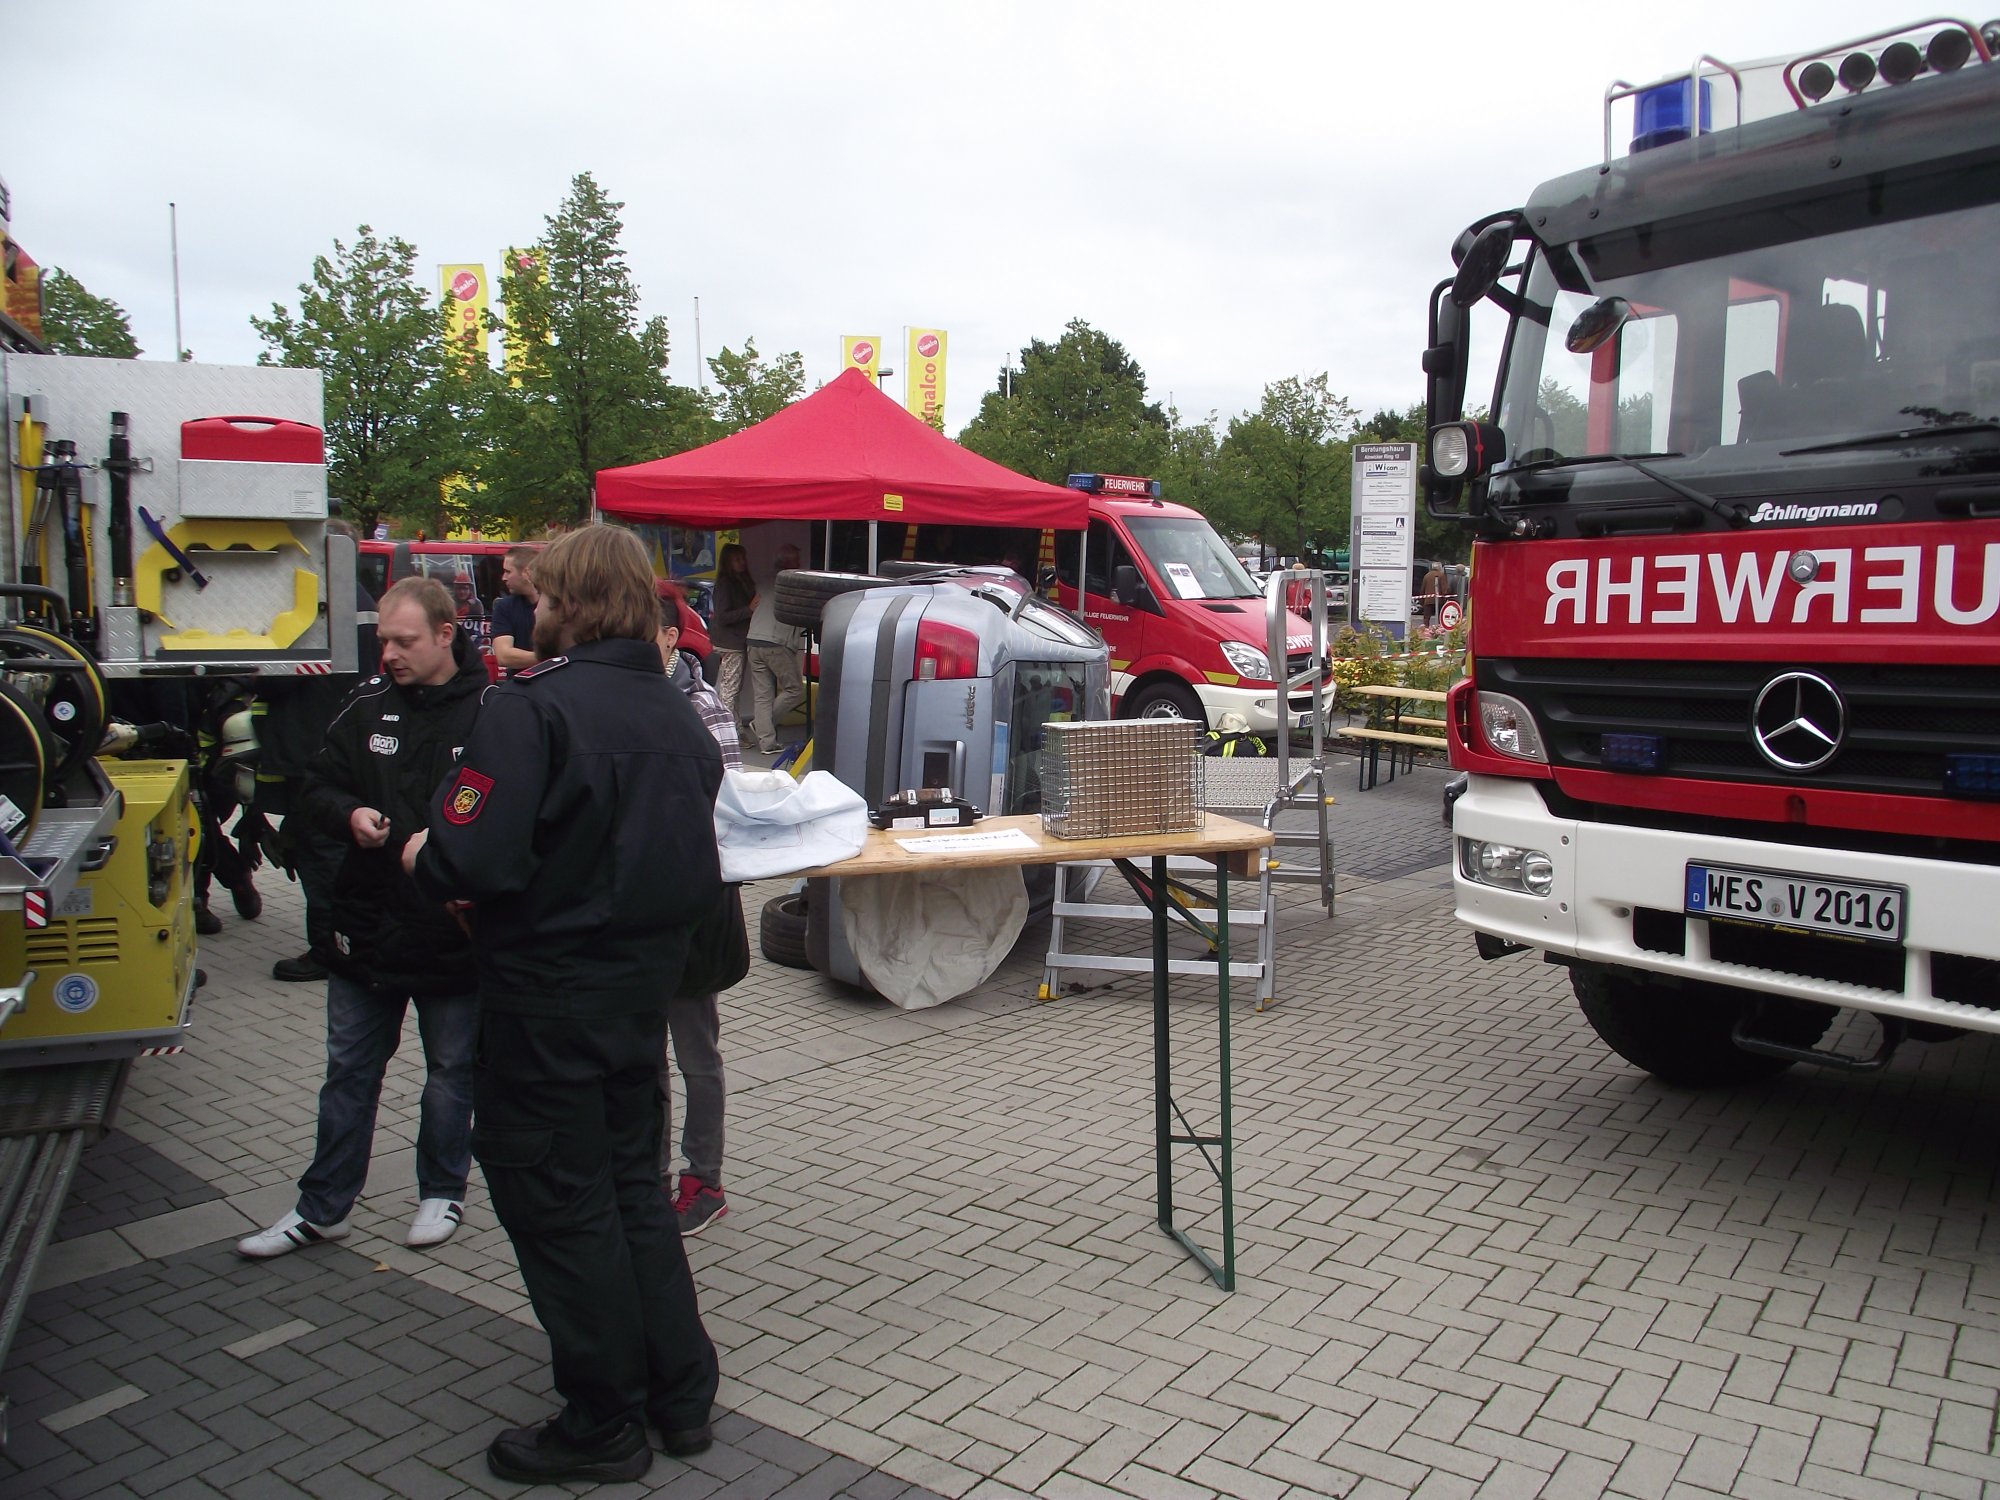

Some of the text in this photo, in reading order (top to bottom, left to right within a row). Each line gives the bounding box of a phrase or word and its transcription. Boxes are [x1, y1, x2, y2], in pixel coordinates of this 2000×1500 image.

[1104, 478, 1145, 492] FEUERWEHR
[1749, 501, 1878, 523] Schlingmann
[1100, 612, 1130, 622] FEUERWEHR
[1692, 892, 1700, 902] D
[1708, 873, 1895, 932] WES V 2016
